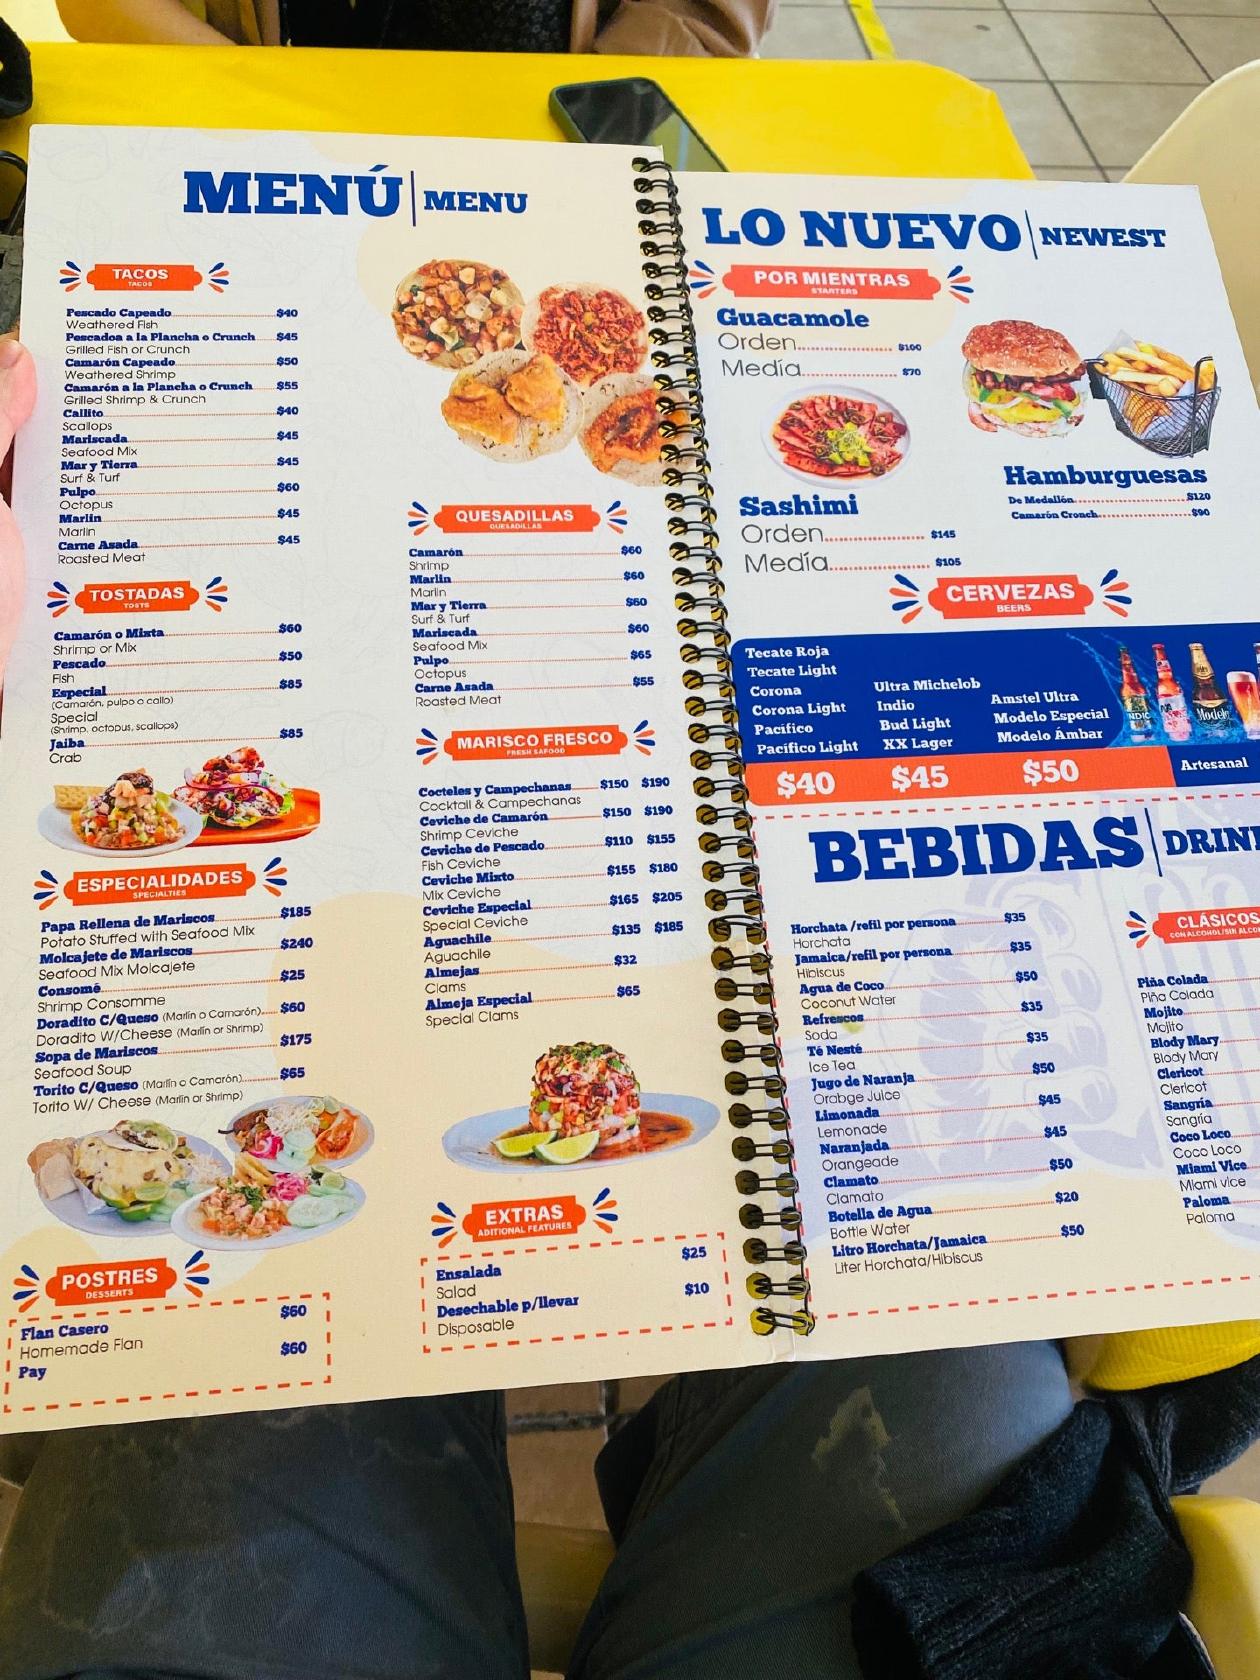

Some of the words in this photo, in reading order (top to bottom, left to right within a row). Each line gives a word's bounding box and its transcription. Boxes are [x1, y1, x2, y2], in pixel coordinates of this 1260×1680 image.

[183, 164, 403, 217] MENÚ
[423, 190, 527, 213] MENU
[701, 207, 785, 246] LO
[799, 210, 1021, 251] NUEVO
[1038, 227, 1166, 247] NEWEST
[111, 268, 168, 279] TACOS
[754, 270, 798, 284] POR
[802, 271, 910, 287] MIENTRAS
[66, 307, 116, 317] Pescado
[119, 307, 171, 319] Capeado
[276, 308, 298, 318] $40
[716, 307, 869, 327] Guacamole
[66, 319, 134, 329] Weathered
[137, 319, 158, 329] Fish
[717, 332, 799, 350] Orden
[902, 367, 921, 376] $70
[61, 433, 128, 444] Mariscada
[276, 430, 298, 441] $45
[61, 446, 114, 457] Seafood
[117, 446, 137, 455] Mix
[1003, 464, 1207, 488] Hamburguesas
[59, 486, 95, 498] Pulpo
[276, 481, 299, 493] $60
[59, 500, 113, 511] Octopus
[739, 493, 859, 516] Sashimi
[1007, 496, 1022, 504] De
[1024, 495, 1075, 504] Medallón
[1186, 492, 1211, 501] $120
[455, 509, 574, 522] QUESADILLAS
[1011, 510, 1059, 519] Camarón
[1060, 509, 1101, 518] Cronch
[1188, 507, 1210, 517] $90
[741, 523, 823, 543] Orden
[930, 529, 956, 539] $145
[57, 541, 95, 550] Carne
[97, 538, 139, 549] Asada
[277, 534, 300, 545] $45
[57, 552, 109, 564] Roasted
[112, 552, 145, 563] Meat
[408, 547, 463, 557] Camarón
[621, 545, 642, 556] $60
[409, 560, 449, 572] Shrimp
[935, 557, 961, 567] $105
[89, 586, 184, 601] TOSTADAS
[946, 582, 1075, 602] CERVEZAS
[996, 603, 1031, 612] BEERS
[52, 657, 106, 669] Pescado
[278, 650, 302, 662] $50
[413, 654, 449, 667] Pulpo
[630, 649, 652, 660] $65
[744, 647, 792, 658] Tecate
[795, 645, 829, 659] Roja
[746, 666, 795, 677] Tecate
[798, 663, 837, 677] Light
[52, 673, 74, 684] Fish
[414, 683, 451, 693] Carne
[453, 681, 494, 691] Asada
[632, 675, 654, 687] $55
[873, 680, 910, 692] Ultra
[912, 677, 980, 690] Michelob
[51, 685, 108, 700] Especial
[279, 678, 302, 689] $85
[749, 685, 801, 697] Corona
[990, 691, 1040, 704] Amstel
[1042, 690, 1079, 702] Ultra
[752, 704, 804, 716] Corona
[807, 701, 846, 716] Light
[876, 699, 914, 711] Indio
[993, 710, 1047, 723] Modelo
[1049, 708, 1109, 723] Especial
[879, 717, 909, 730] Bud
[912, 716, 951, 731] Light
[49, 737, 85, 752] Jaiba
[279, 727, 303, 739] $85
[457, 734, 539, 749] MARISCO
[543, 731, 612, 746] FRESCO
[996, 730, 1051, 742] Modelo
[1054, 728, 1102, 740] Ámbar
[818, 739, 858, 754] Light
[882, 738, 908, 750] XX
[911, 737, 953, 751] Lager
[49, 752, 81, 764] Crab
[1180, 756, 1248, 770] Artesanal
[891, 764, 949, 792] $45
[1022, 758, 1079, 786] $50
[777, 770, 835, 799] $40
[808, 815, 1144, 883] BEBIDAS
[1162, 826, 1260, 855] DRIN
[77, 870, 242, 892] ESPECIALIDADES
[132, 889, 186, 898] SPECIALTIES
[1177, 912, 1260, 928] CLÁSICOS
[423, 932, 491, 949] Aguachile
[611, 923, 641, 936] $135
[654, 920, 683, 934] $185
[39, 950, 108, 964] Molcajete
[110, 948, 127, 960] de
[129, 946, 193, 959] Mariscos
[280, 937, 313, 950] $240
[424, 965, 479, 978] Almejas
[613, 954, 637, 966] $32
[279, 969, 305, 982] $25
[424, 982, 466, 994] Clams
[37, 1001, 83, 1013] Shrimp
[86, 996, 165, 1010] Consomme
[1143, 1005, 1183, 1019] Mojito
[1156, 1066, 1204, 1079] Clericot
[815, 1106, 880, 1122] Limonada
[1038, 1093, 1061, 1106] $45
[817, 1122, 887, 1138] Lemonade
[1182, 1194, 1231, 1208] Paloma
[485, 1204, 563, 1225] EXTRAS
[478, 1226, 525, 1236] ADITIONAL
[527, 1221, 572, 1232] FEATURES
[436, 1263, 502, 1281] Ensalada
[681, 1246, 707, 1260] $25
[62, 1267, 158, 1290] POSTRES
[85, 1288, 133, 1299] DESSERTS
[436, 1283, 476, 1299] Salad
[437, 1298, 519, 1318] Desechable
[521, 1295, 579, 1313] p/llevar
[684, 1282, 709, 1296] $10
[20, 1326, 54, 1341] Flan
[58, 1324, 109, 1337] Casero
[280, 1304, 307, 1319] $60
[437, 1318, 514, 1337] Disposable
[19, 1339, 109, 1359] Homemade
[113, 1337, 143, 1351] Flan
[18, 1366, 47, 1381] Pay
[280, 1341, 307, 1356] $60
